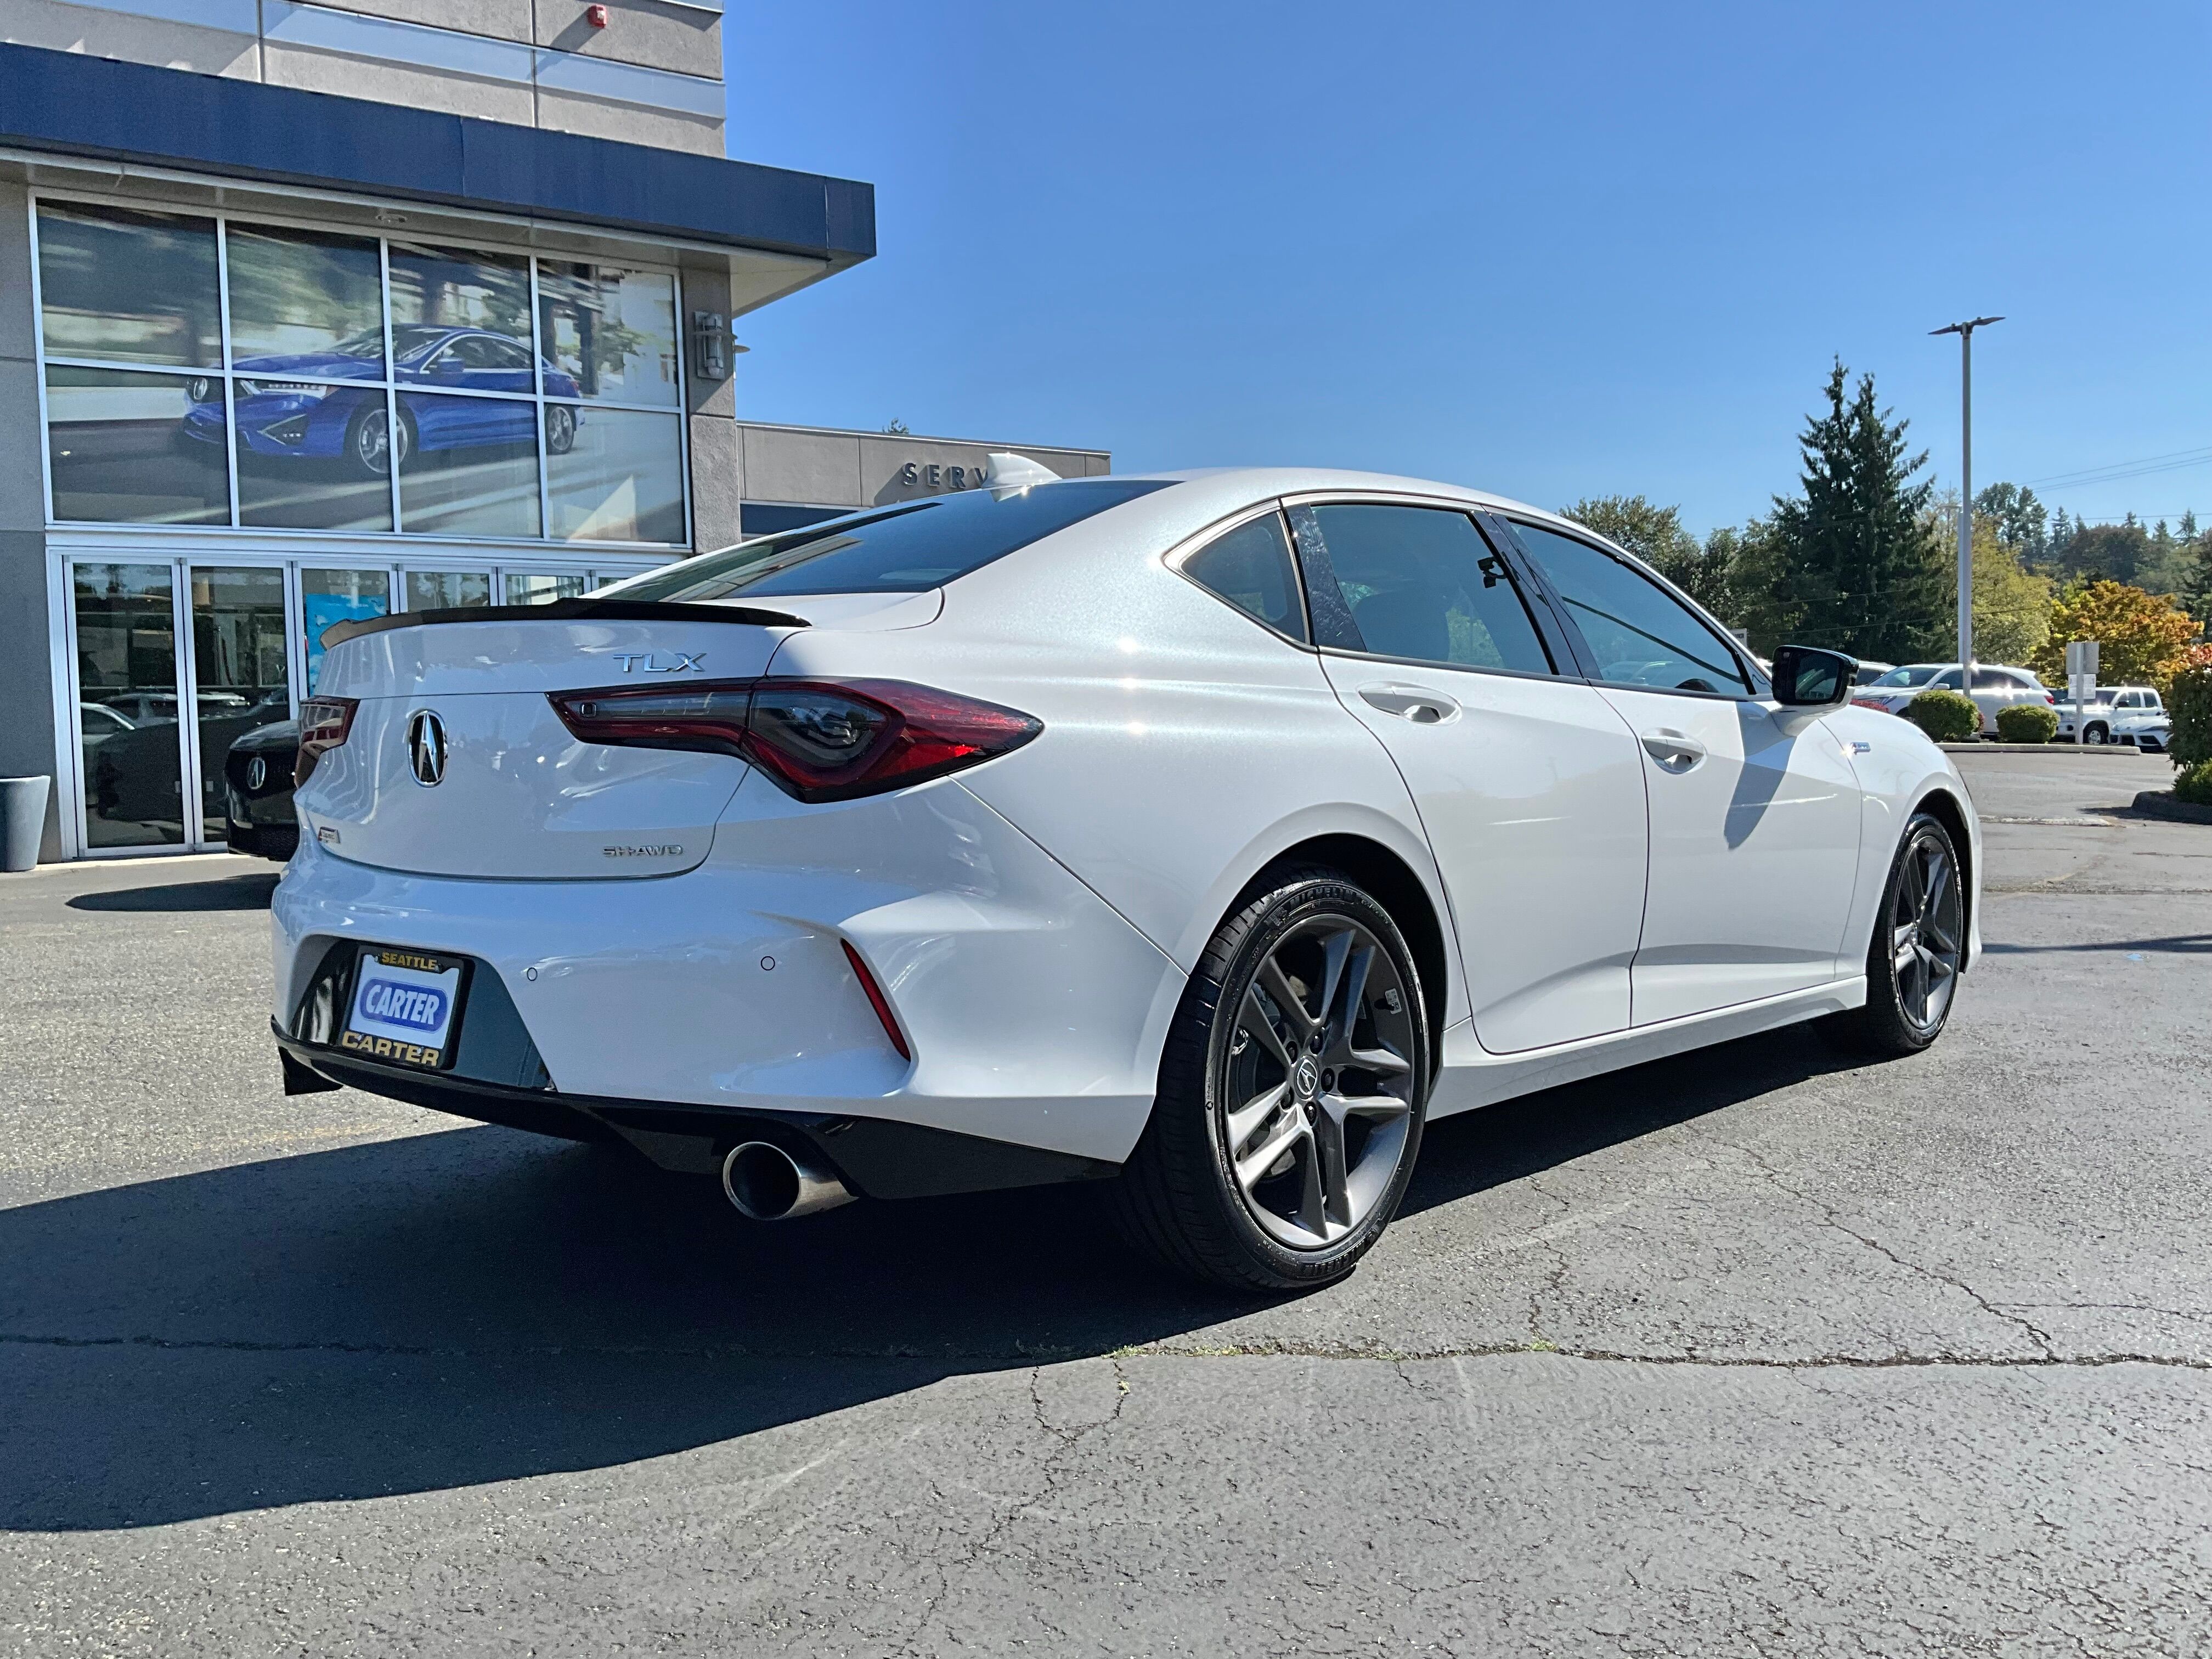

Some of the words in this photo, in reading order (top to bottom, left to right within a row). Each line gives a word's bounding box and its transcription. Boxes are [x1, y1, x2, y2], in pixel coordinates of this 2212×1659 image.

[902, 462, 988, 488] SERV
[613, 653, 707, 672] TLX
[381, 952, 438, 970] SEATTLE
[365, 984, 439, 1025] CARTER
[342, 1031, 439, 1066] CARTER
